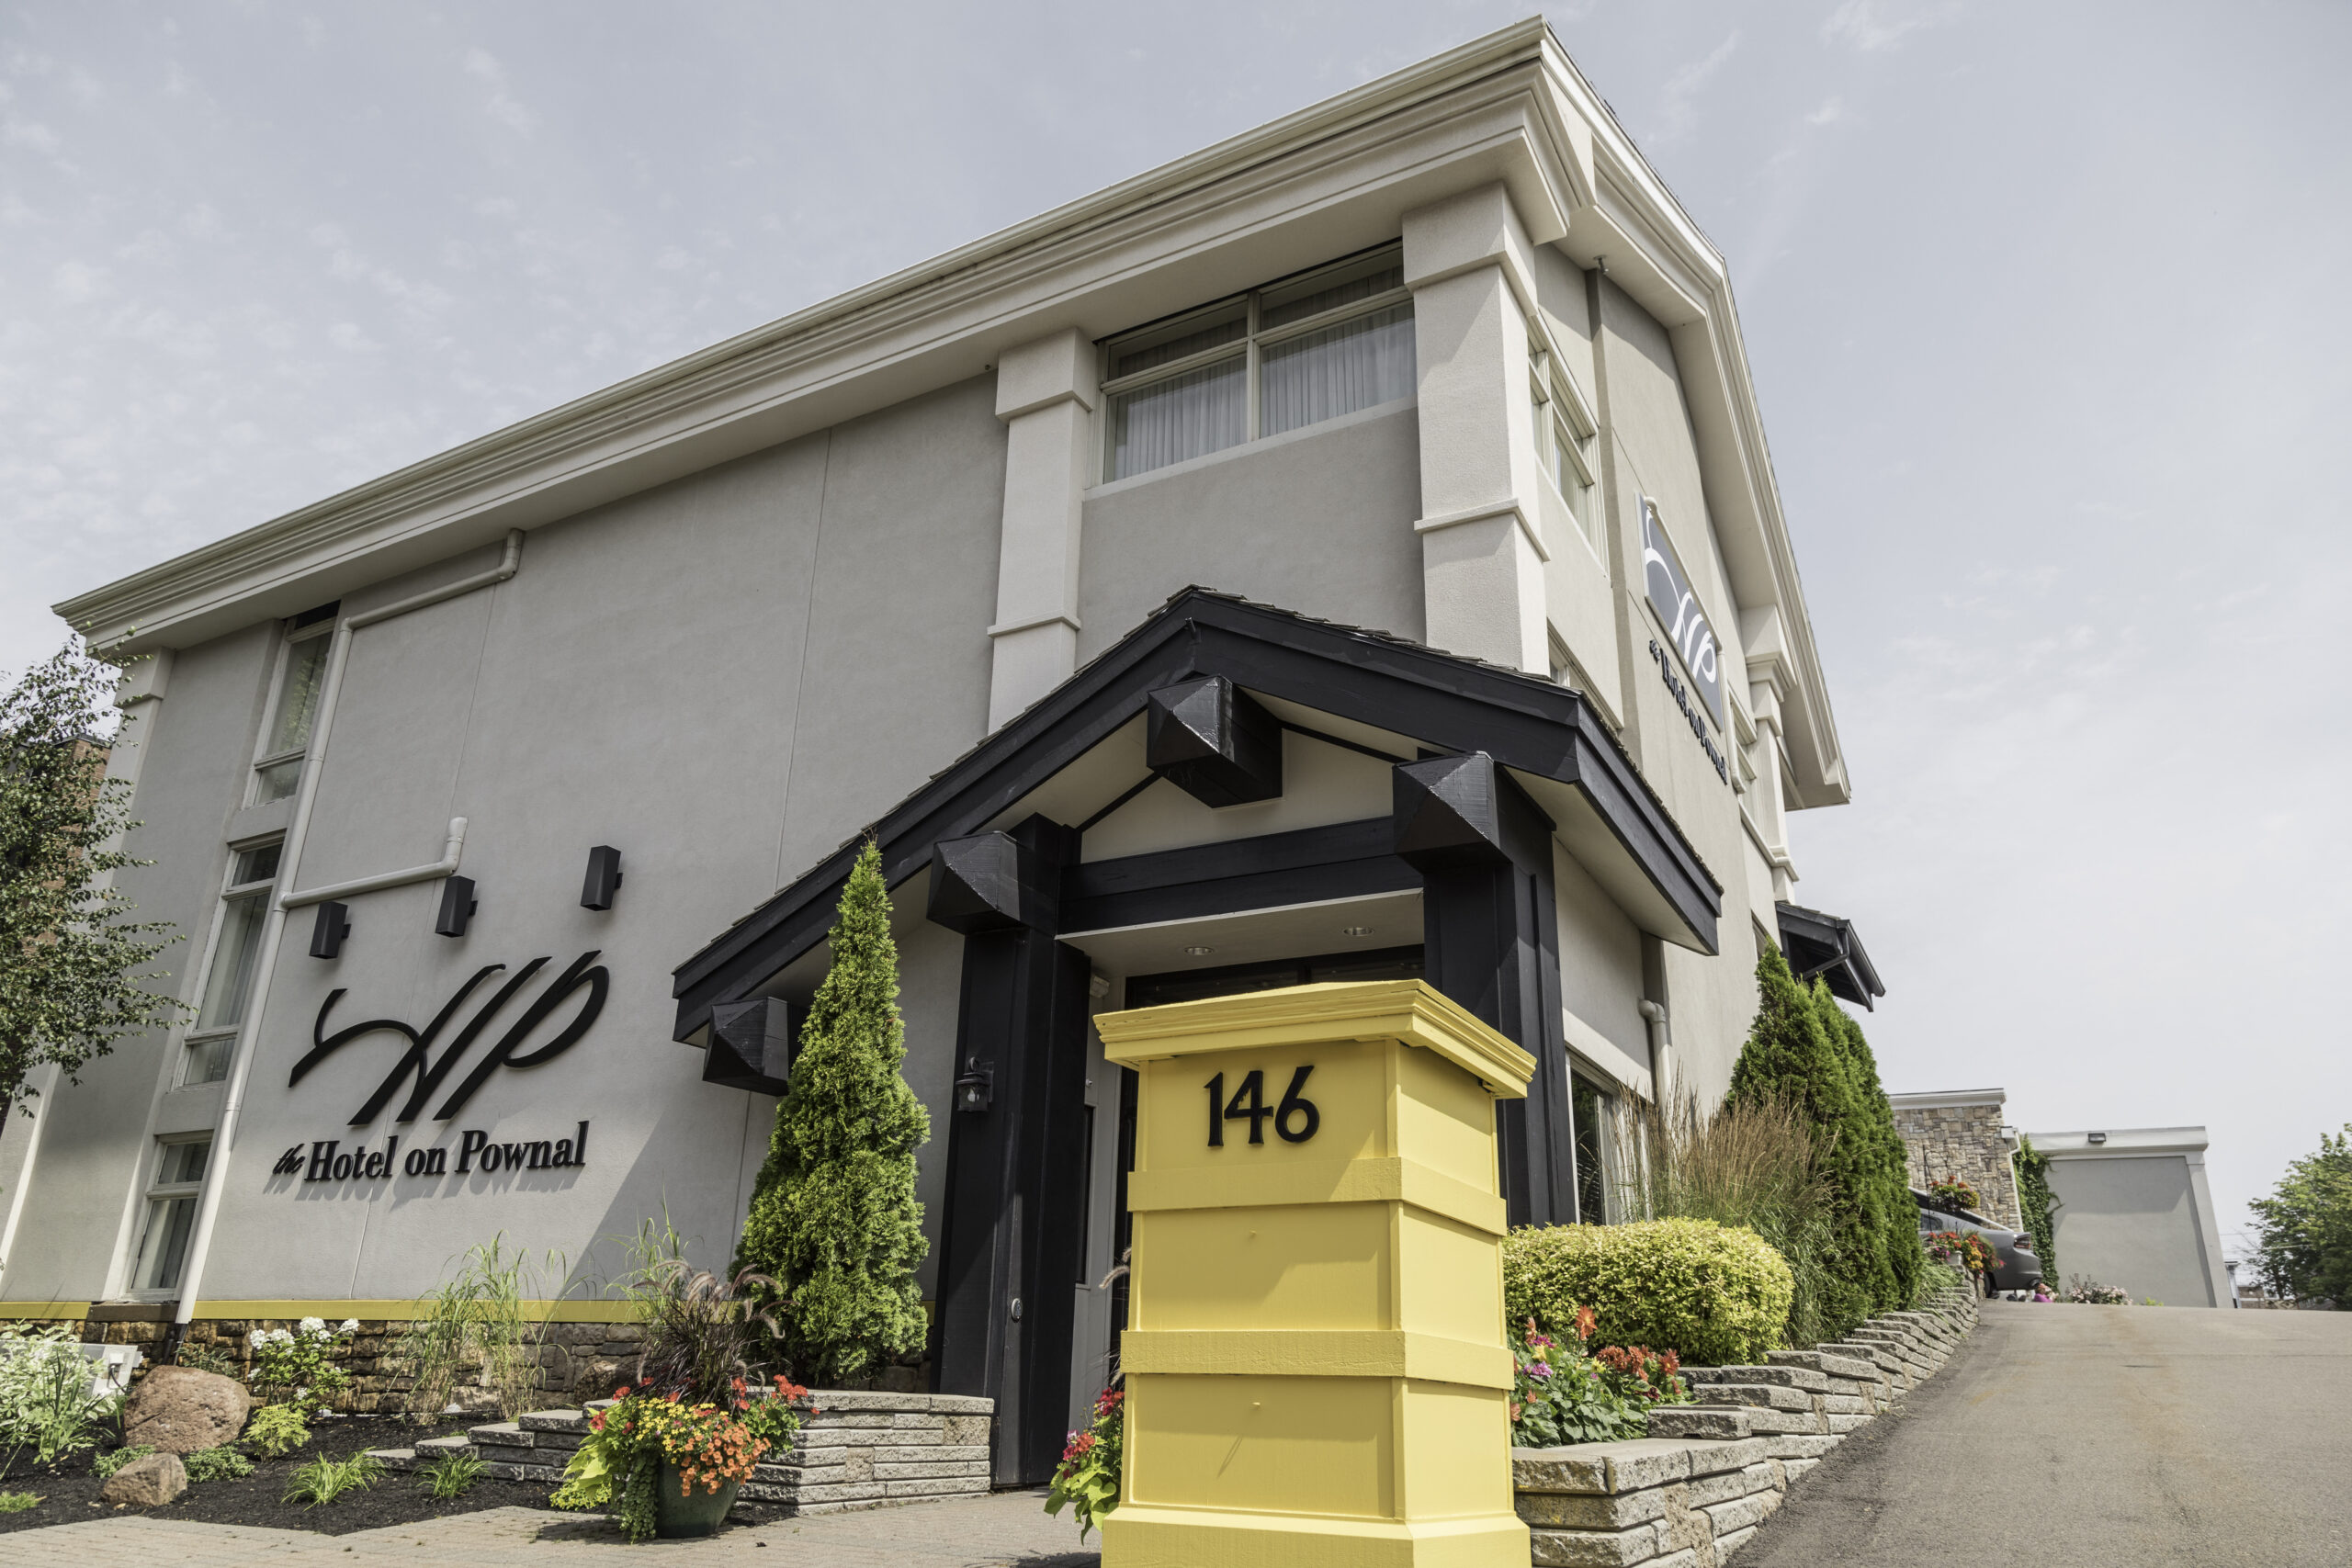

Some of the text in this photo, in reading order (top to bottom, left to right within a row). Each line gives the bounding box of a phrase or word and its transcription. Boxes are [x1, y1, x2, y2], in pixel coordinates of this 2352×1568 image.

[1204, 1065, 1320, 1146] 146
[272, 1121, 590, 1181] the Hotel on Pownal
